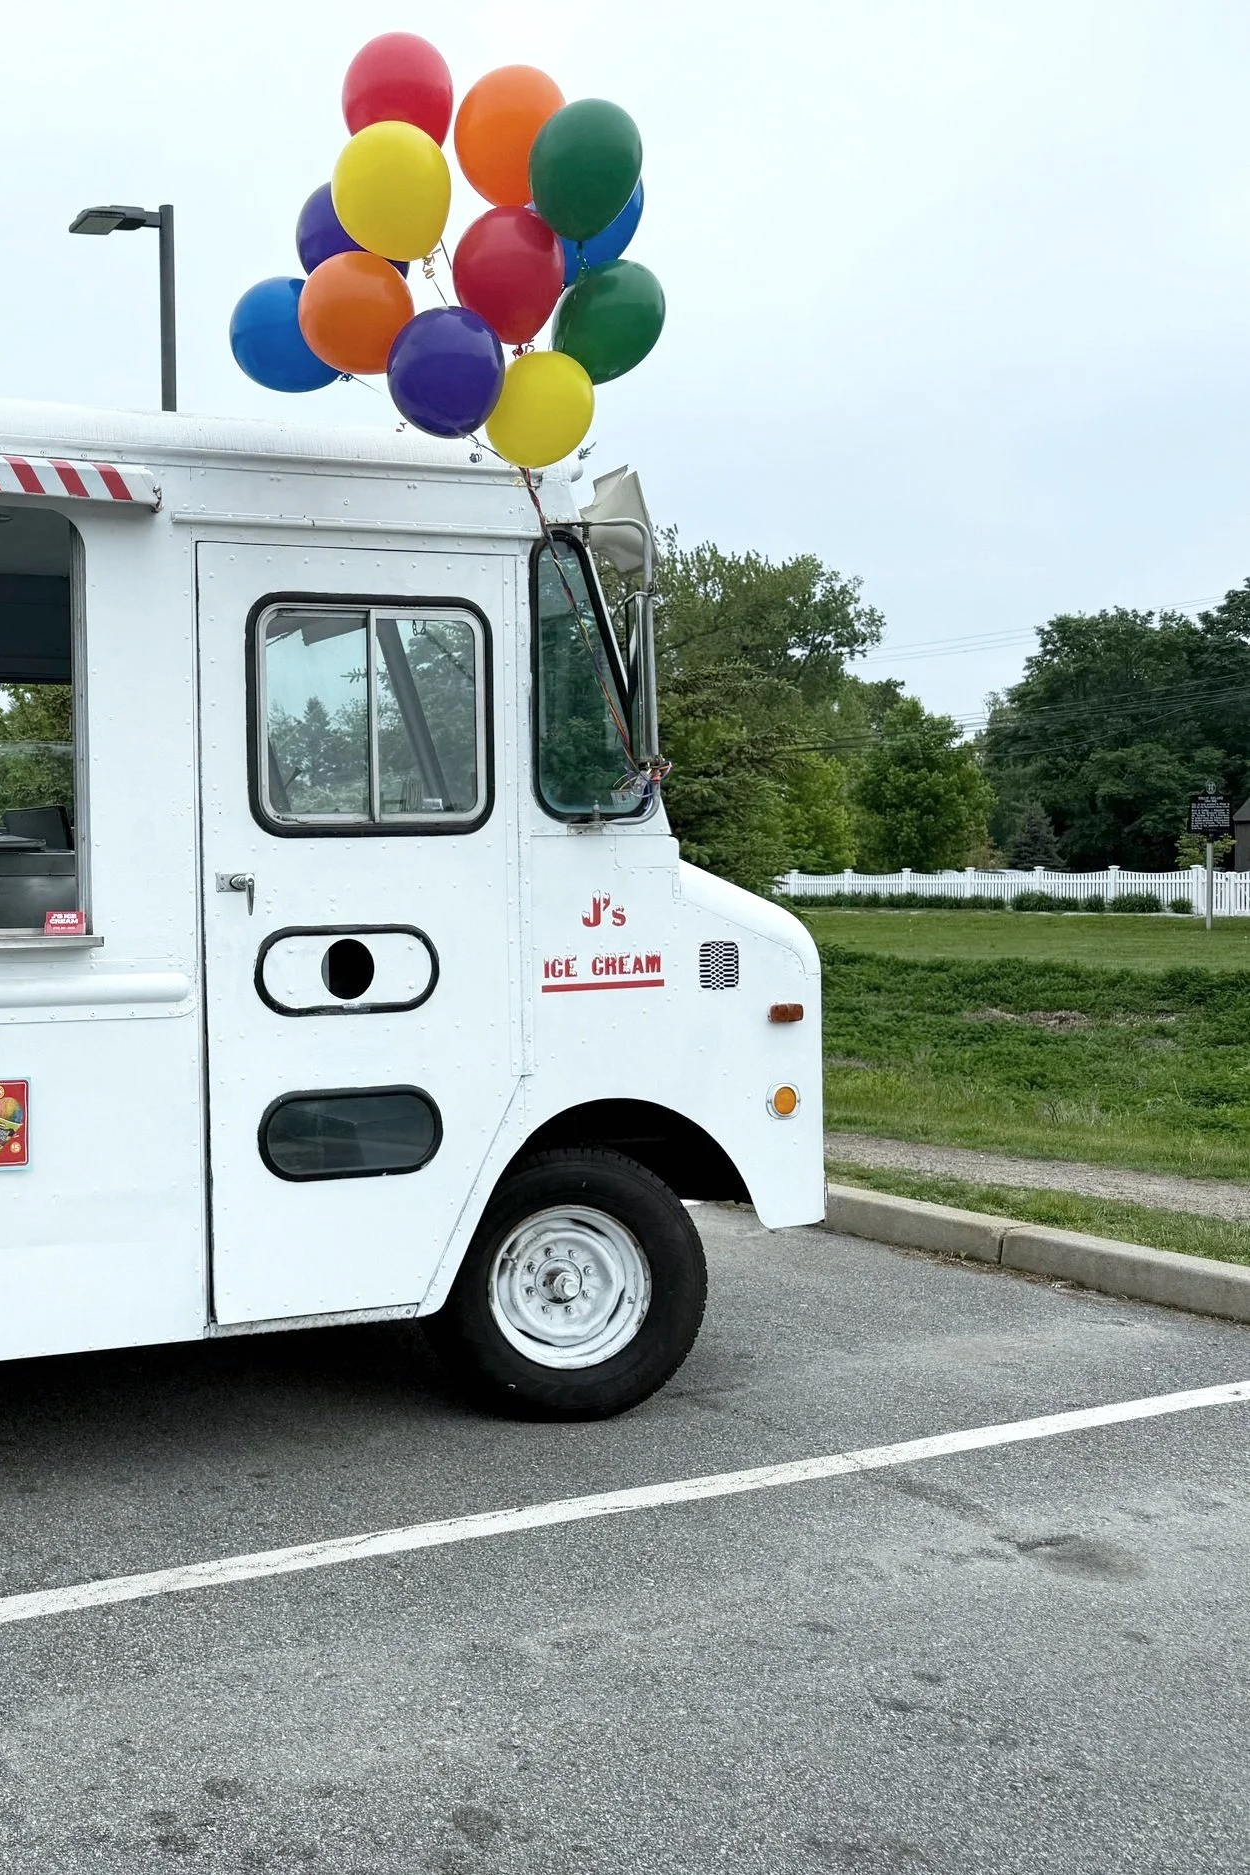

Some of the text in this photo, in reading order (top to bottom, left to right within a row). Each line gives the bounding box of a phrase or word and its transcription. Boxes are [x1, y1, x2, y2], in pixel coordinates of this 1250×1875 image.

[581, 889, 627, 928] J's
[543, 951, 662, 979] ICE CREAM
